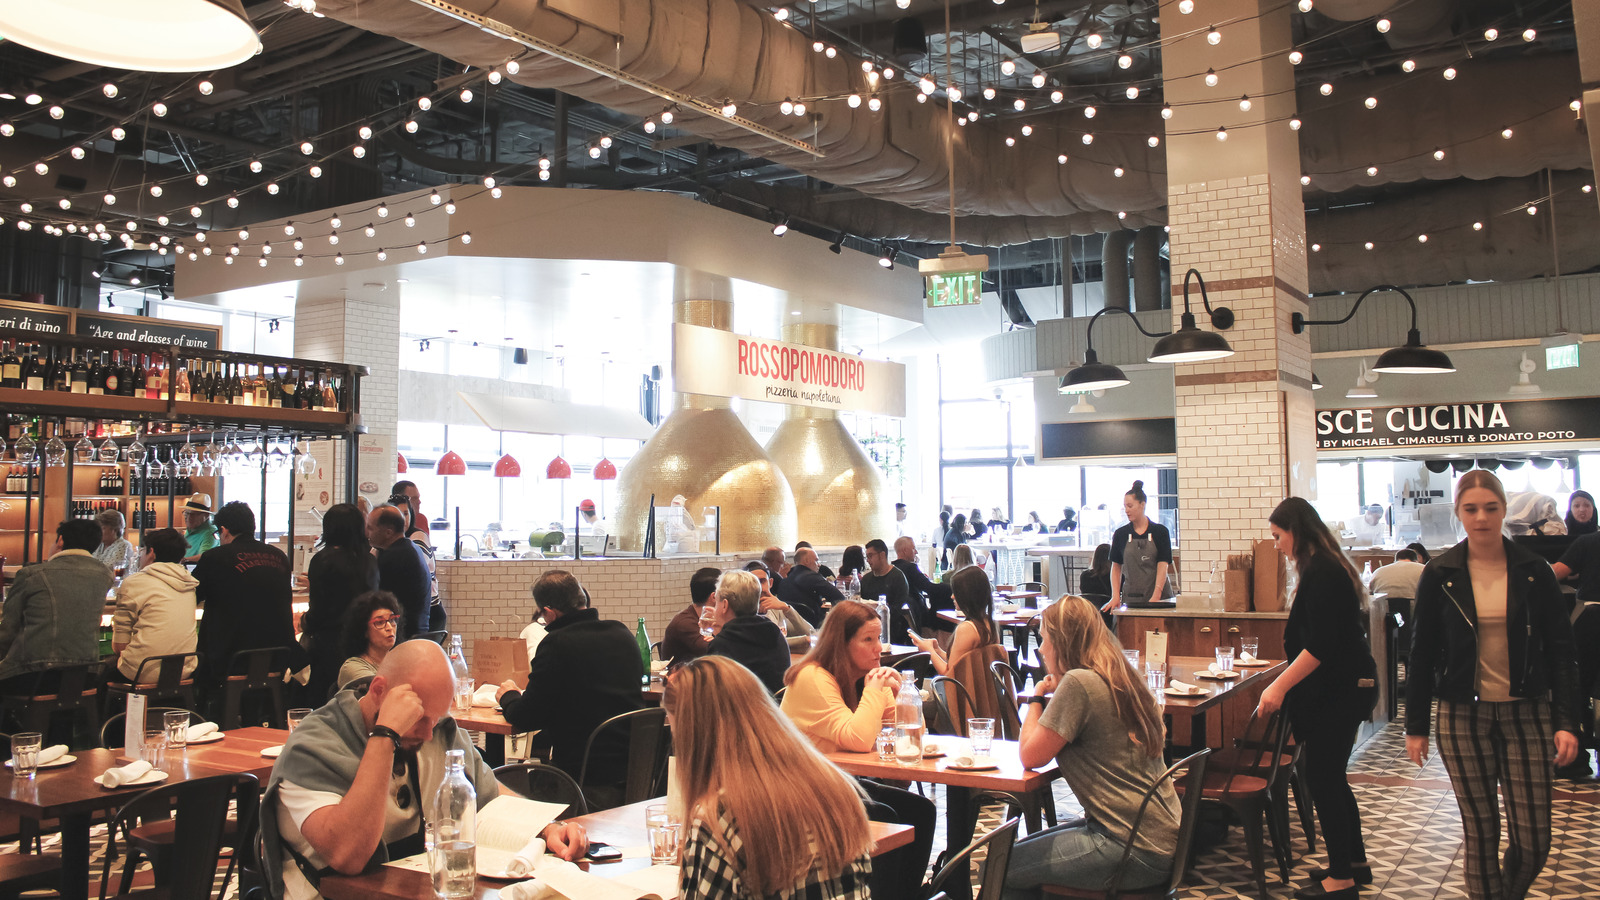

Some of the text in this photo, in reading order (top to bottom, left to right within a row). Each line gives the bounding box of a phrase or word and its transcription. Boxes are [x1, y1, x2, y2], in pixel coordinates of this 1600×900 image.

[933, 275, 976, 306] EXIT
[19, 316, 33, 331] di
[35, 320, 61, 334] vino
[116, 328, 137, 342] and
[138, 330, 172, 345] glasses
[173, 334, 186, 347] of
[186, 337, 209, 349] wine
[738, 338, 865, 392] ROSSOPOMODORO
[765, 383, 842, 405] pizzeria napoletana
[1317, 403, 1510, 435] SCE CUCINA
[1323, 439, 1338, 448] BY
[1341, 437, 1394, 447] MICHAEL
[1397, 434, 1464, 446] CIMARUSTI
[1467, 433, 1476, 443] &
[1479, 431, 1534, 442] DONATO
[1537, 430, 1576, 440] POTO
